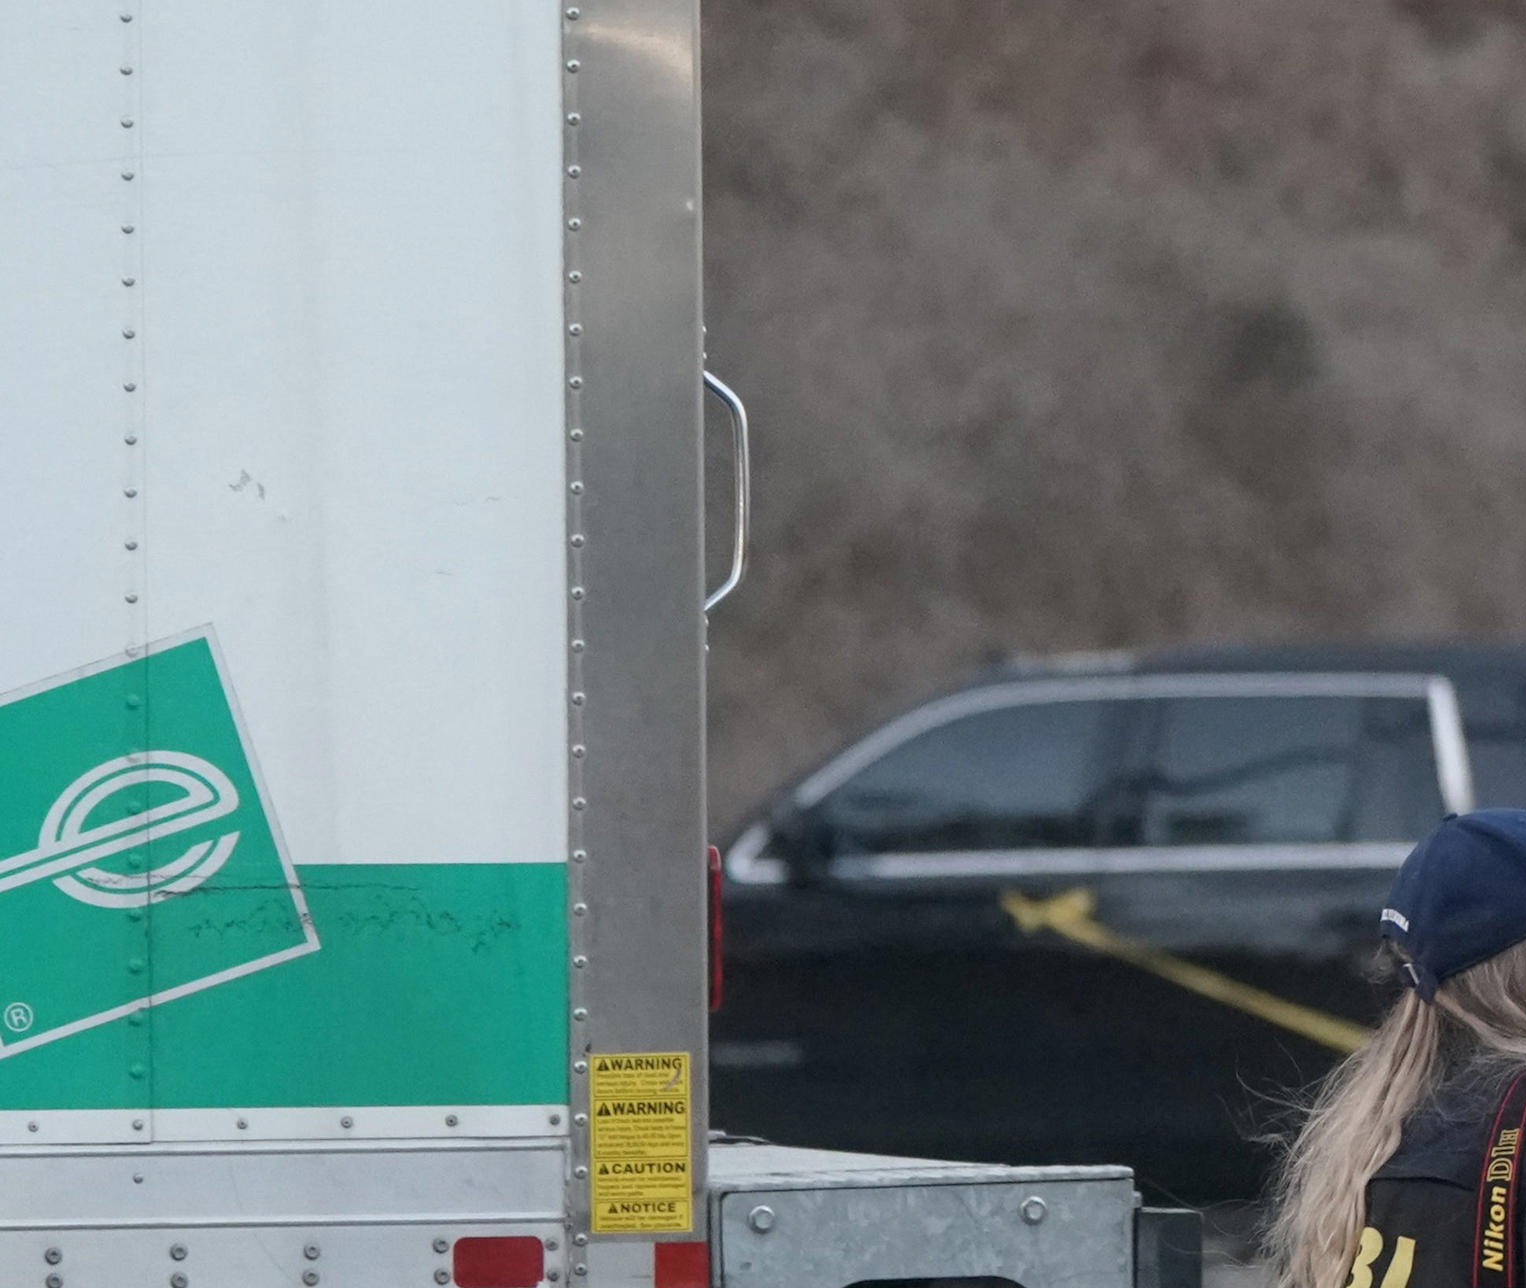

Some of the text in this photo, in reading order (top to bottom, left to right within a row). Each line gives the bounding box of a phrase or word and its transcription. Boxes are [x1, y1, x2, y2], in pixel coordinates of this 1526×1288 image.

[610, 1058, 682, 1071] WARNING
[612, 1101, 686, 1115] WARNING
[612, 1162, 686, 1174] CAUTION
[620, 1202, 676, 1213] NOTICE
[1482, 1185, 1507, 1272] Nikon
